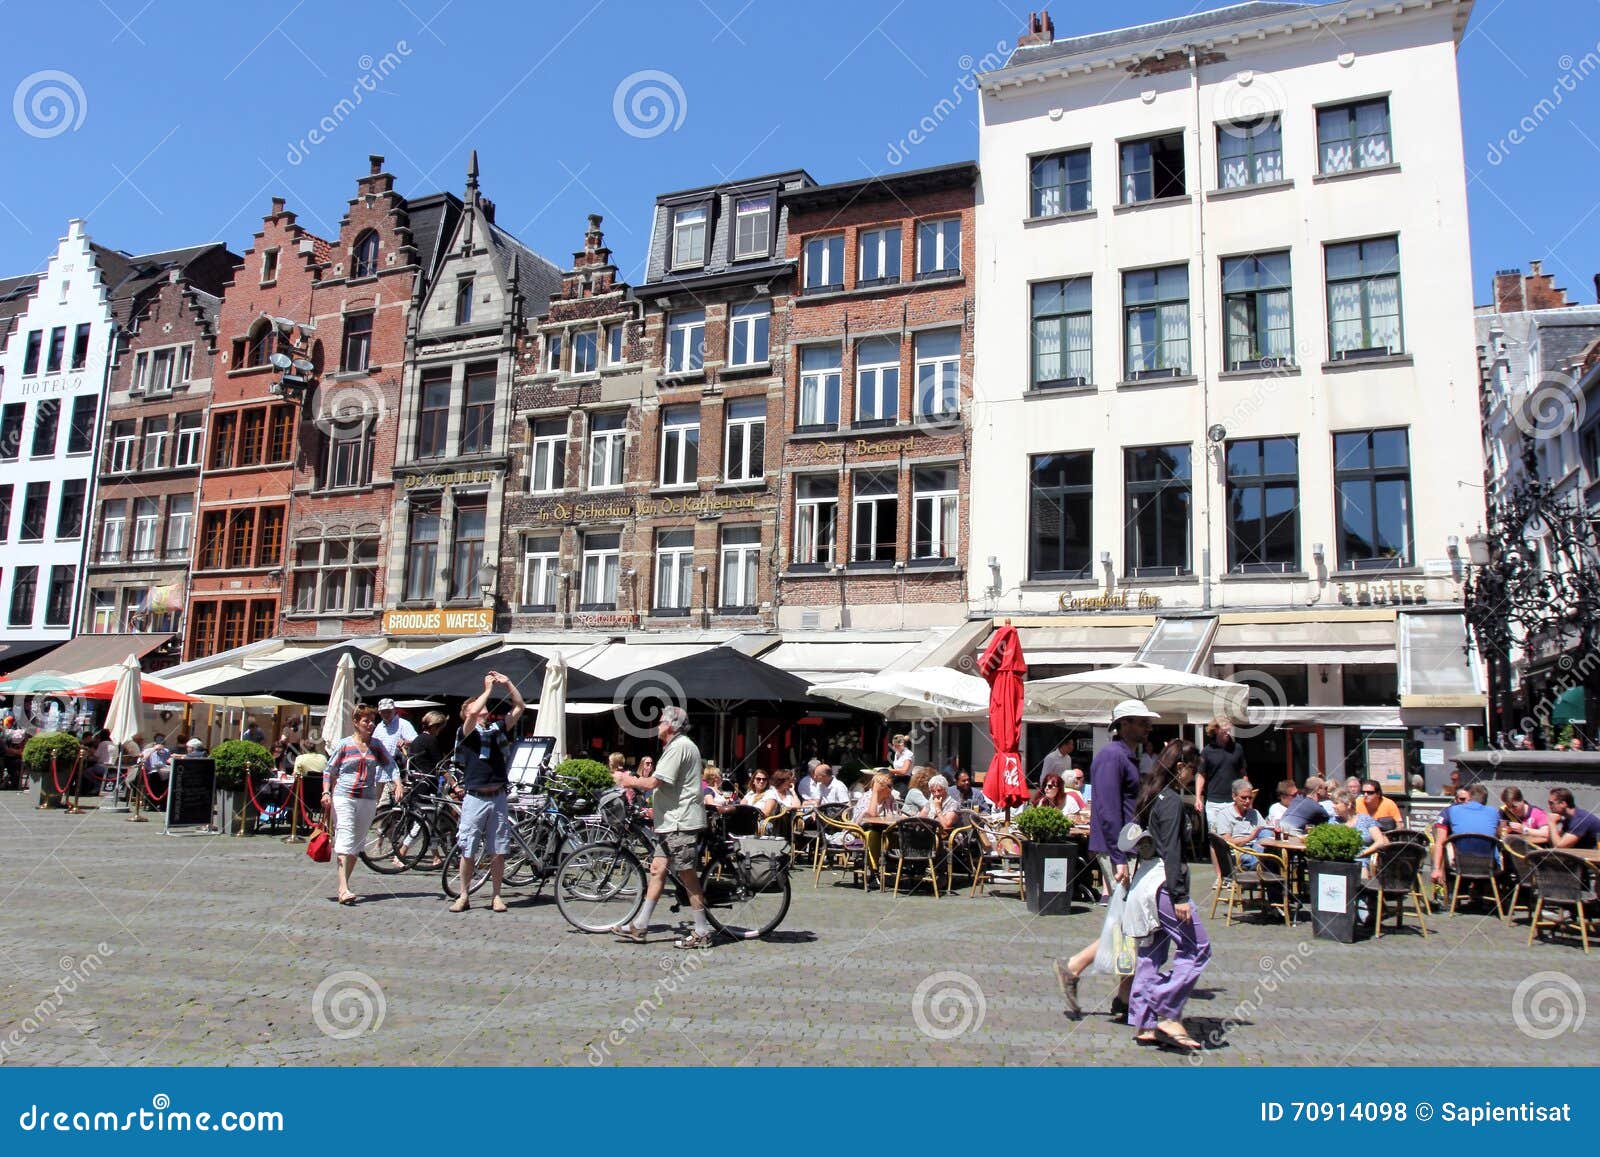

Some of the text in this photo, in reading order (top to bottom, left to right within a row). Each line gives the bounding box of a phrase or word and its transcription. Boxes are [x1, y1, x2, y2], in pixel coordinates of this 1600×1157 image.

[553, 504, 570, 520] De
[575, 503, 631, 519] Schaduw
[636, 498, 657, 515] Van
[660, 497, 681, 513] De
[683, 495, 755, 512] Kathedraal
[389, 613, 487, 629] BROODJES WAFELS
